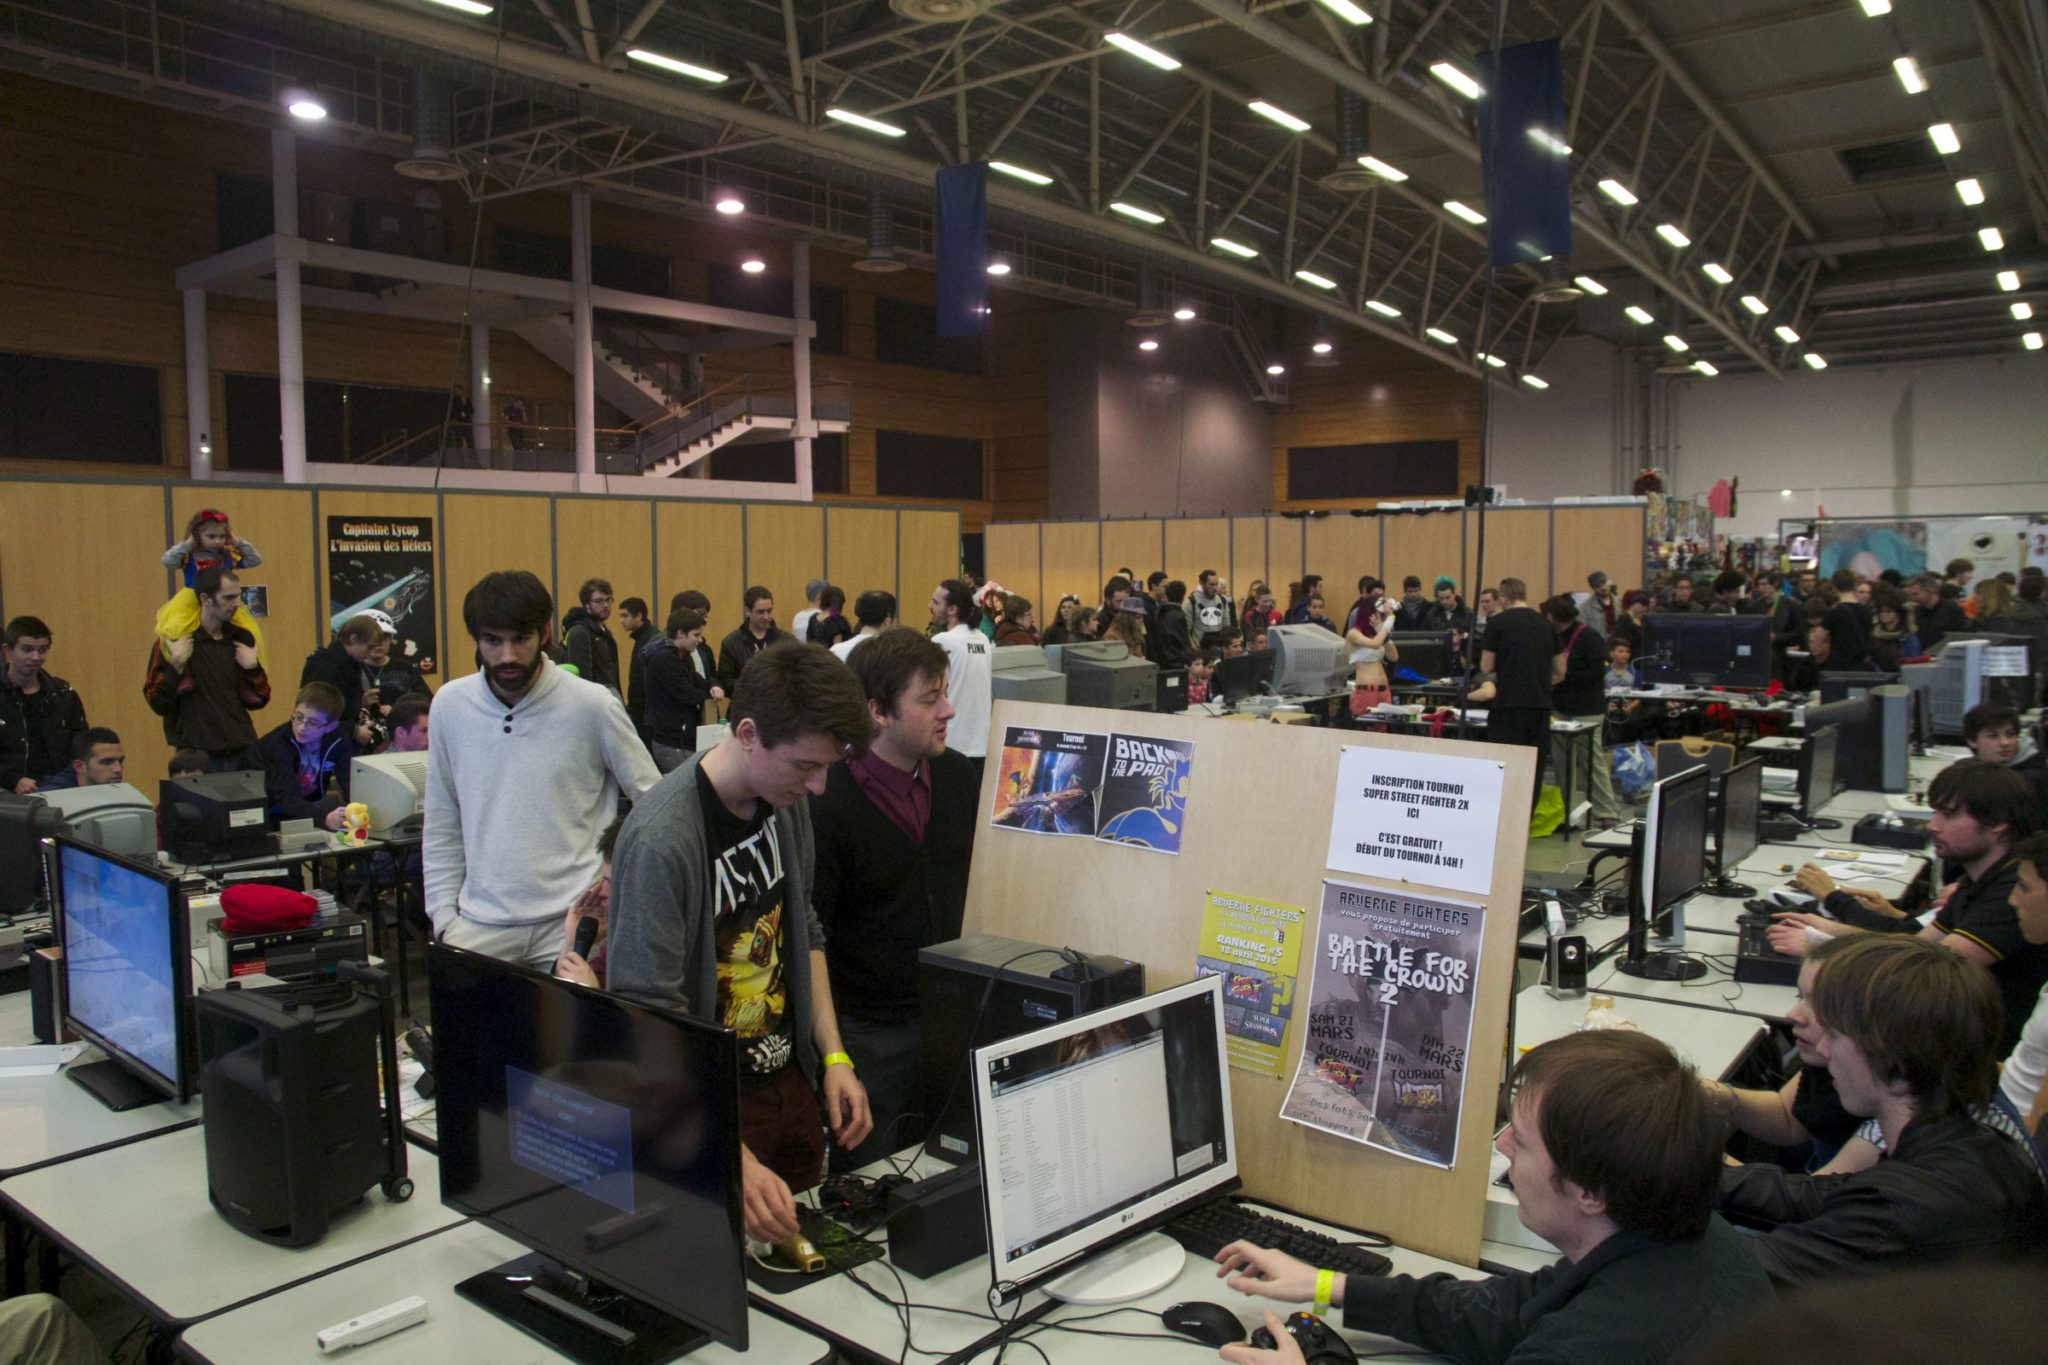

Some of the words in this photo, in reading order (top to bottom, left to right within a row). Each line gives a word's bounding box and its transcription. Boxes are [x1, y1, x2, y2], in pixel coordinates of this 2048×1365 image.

[343, 523, 389, 537] Capitaine
[392, 523, 419, 537] Lycop
[330, 539, 381, 552] L'invasion
[384, 539, 400, 552] des
[1116, 737, 1170, 764] BACK
[1111, 768, 1126, 777] THE
[1126, 761, 1165, 777] PAD
[1115, 759, 1127, 769] TO
[1371, 774, 1424, 790] INSCRIPTION
[1426, 780, 1464, 795] TOURNOI
[1363, 787, 1389, 800] SUPER
[1390, 791, 1420, 804] STREET
[1421, 795, 1456, 809] FIGHTER
[1457, 799, 1470, 811] 2X
[1406, 807, 1420, 819] ICI
[1378, 831, 1401, 845] C'EST
[1402, 835, 1437, 850] GRATUIT
[1438, 840, 1443, 851] !
[1355, 842, 1382, 856] DÉBUT
[1383, 846, 1395, 858] DU
[1396, 849, 1433, 864] TOURNOI
[1434, 853, 1441, 866] À
[1442, 856, 1458, 869] 14H
[1459, 858, 1464, 869] !
[1254, 904, 1300, 923] FIGHTERS
[1340, 891, 1397, 913] ARVERNE
[1403, 902, 1469, 925] FIGHTERS
[1340, 909, 1361, 917] vous
[1362, 913, 1398, 926] propose
[1400, 918, 1411, 927] de
[1412, 922, 1461, 936] participer
[1372, 923, 1431, 940] gratuitement
[1217, 934, 1266, 953] RANKING
[1328, 933, 1414, 967] BATTLE
[1425, 952, 1469, 980] FOR
[1327, 951, 1374, 977] THE
[1384, 959, 1464, 995] CROWN
[1379, 982, 1399, 1006] 2
[1310, 1014, 1335, 1025] SAM
[1338, 1015, 1354, 1026] 21
[1310, 1026, 1355, 1040] MARS
[1319, 1041, 1371, 1070] TOURNOI
[1421, 1035, 1444, 1050] DIM
[1447, 1045, 1465, 1059] 22
[1419, 1045, 1464, 1073] MARS
[1390, 1068, 1445, 1080] TOURNOI
